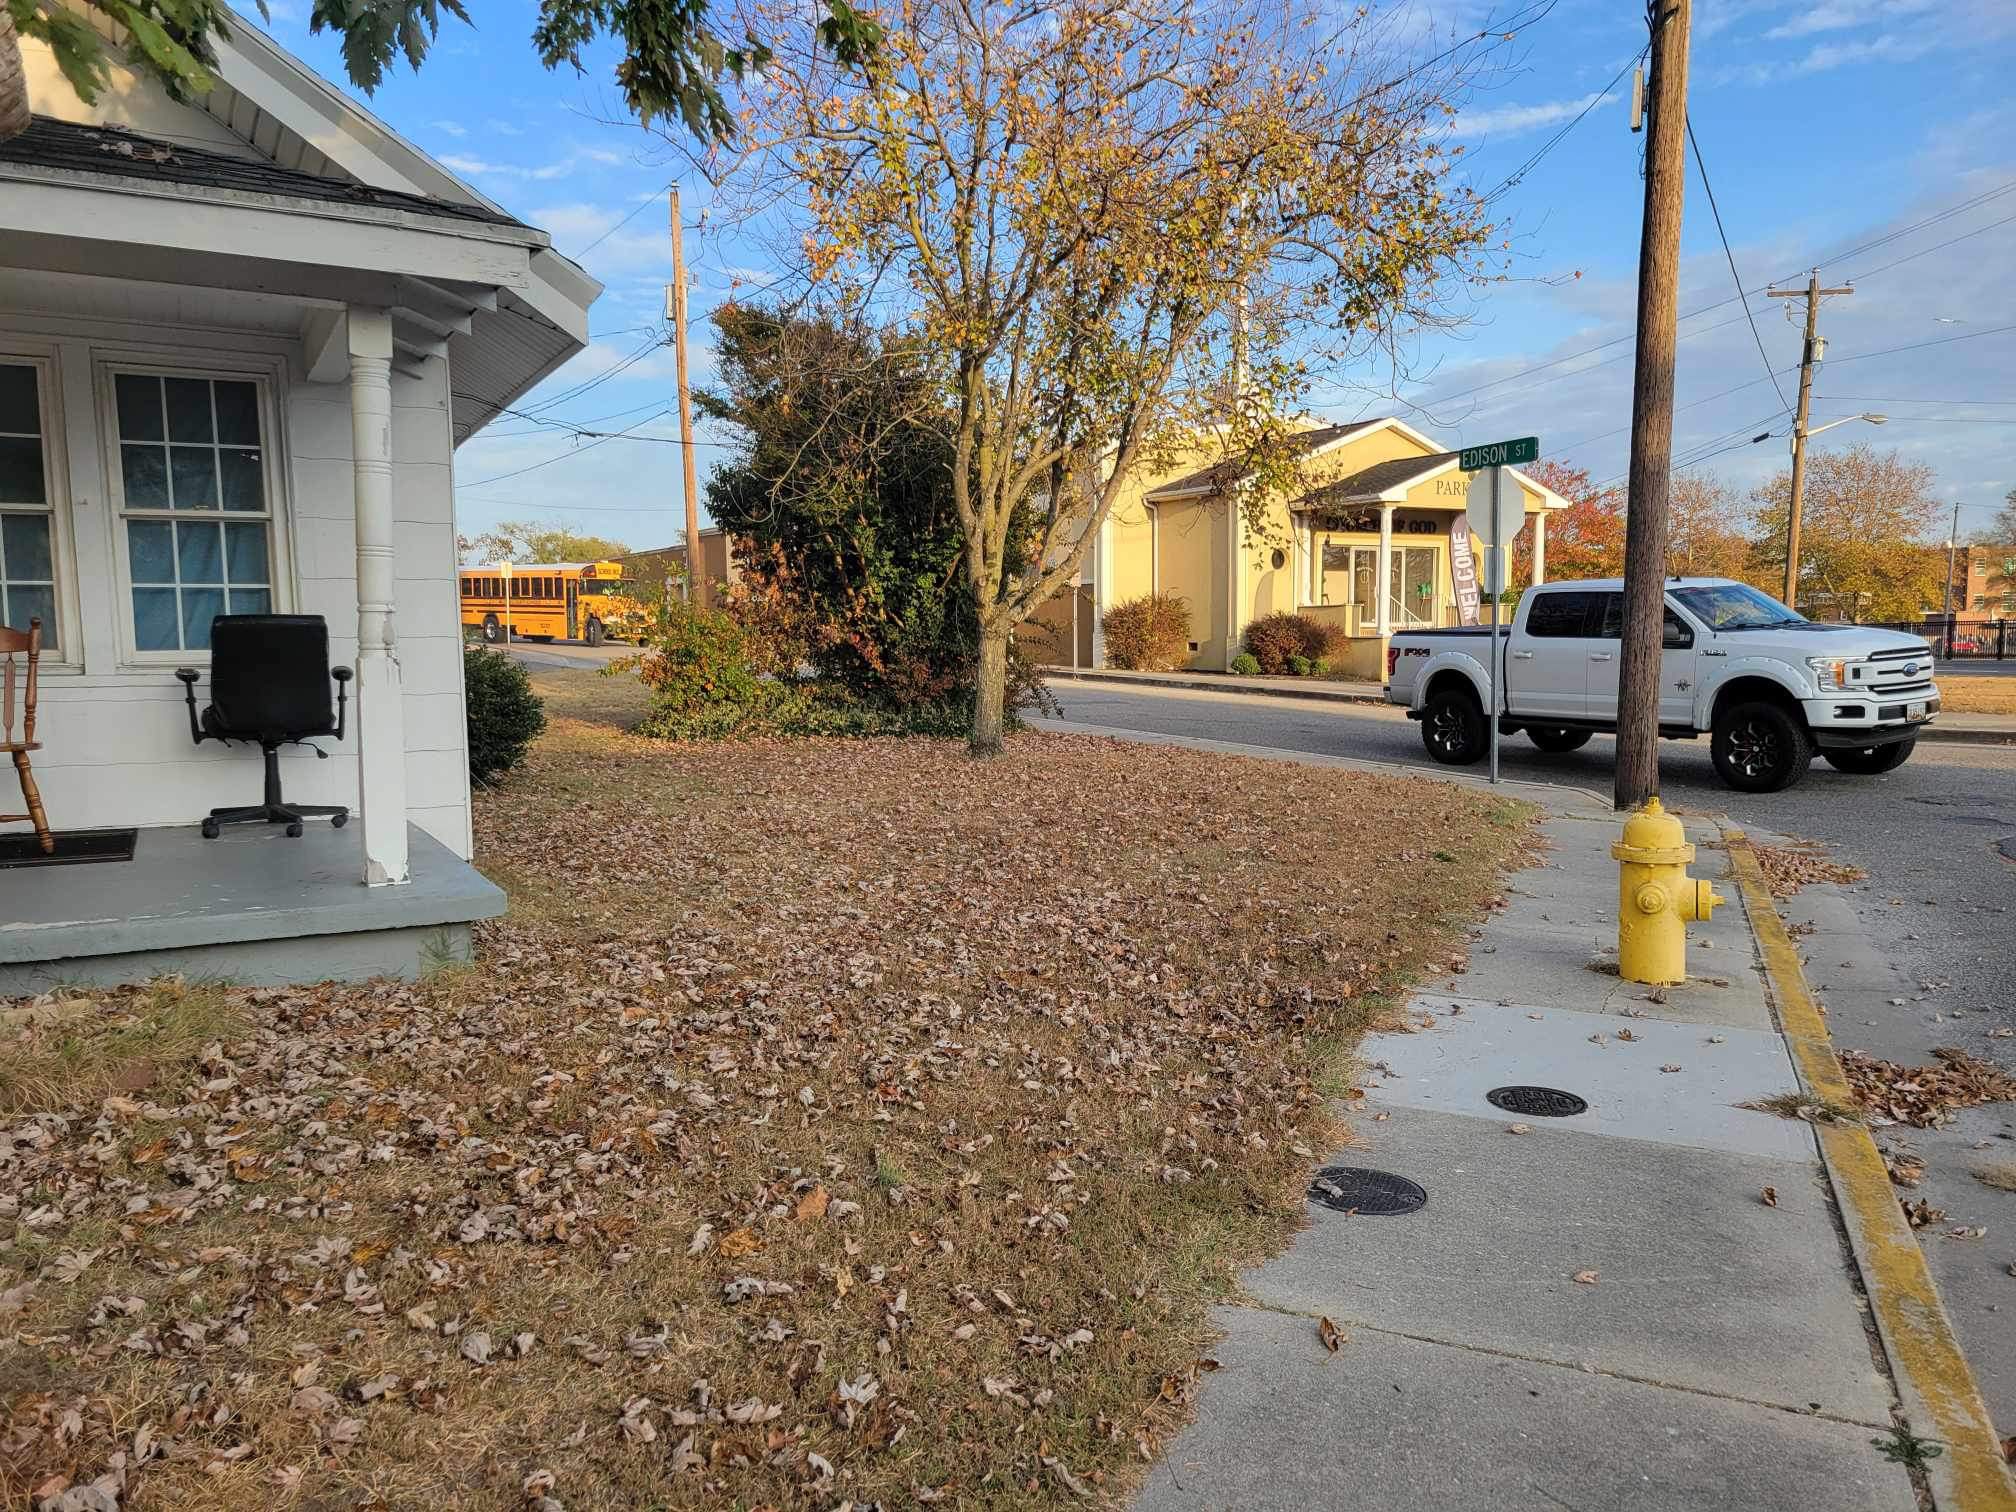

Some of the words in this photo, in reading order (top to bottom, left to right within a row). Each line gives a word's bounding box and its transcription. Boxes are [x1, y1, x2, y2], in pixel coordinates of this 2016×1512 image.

[1462, 444, 1508, 468] EDISON
[1515, 443, 1528, 457] ST
[1408, 520, 1437, 534] GOD
[1452, 530, 1478, 620] WELCOME
